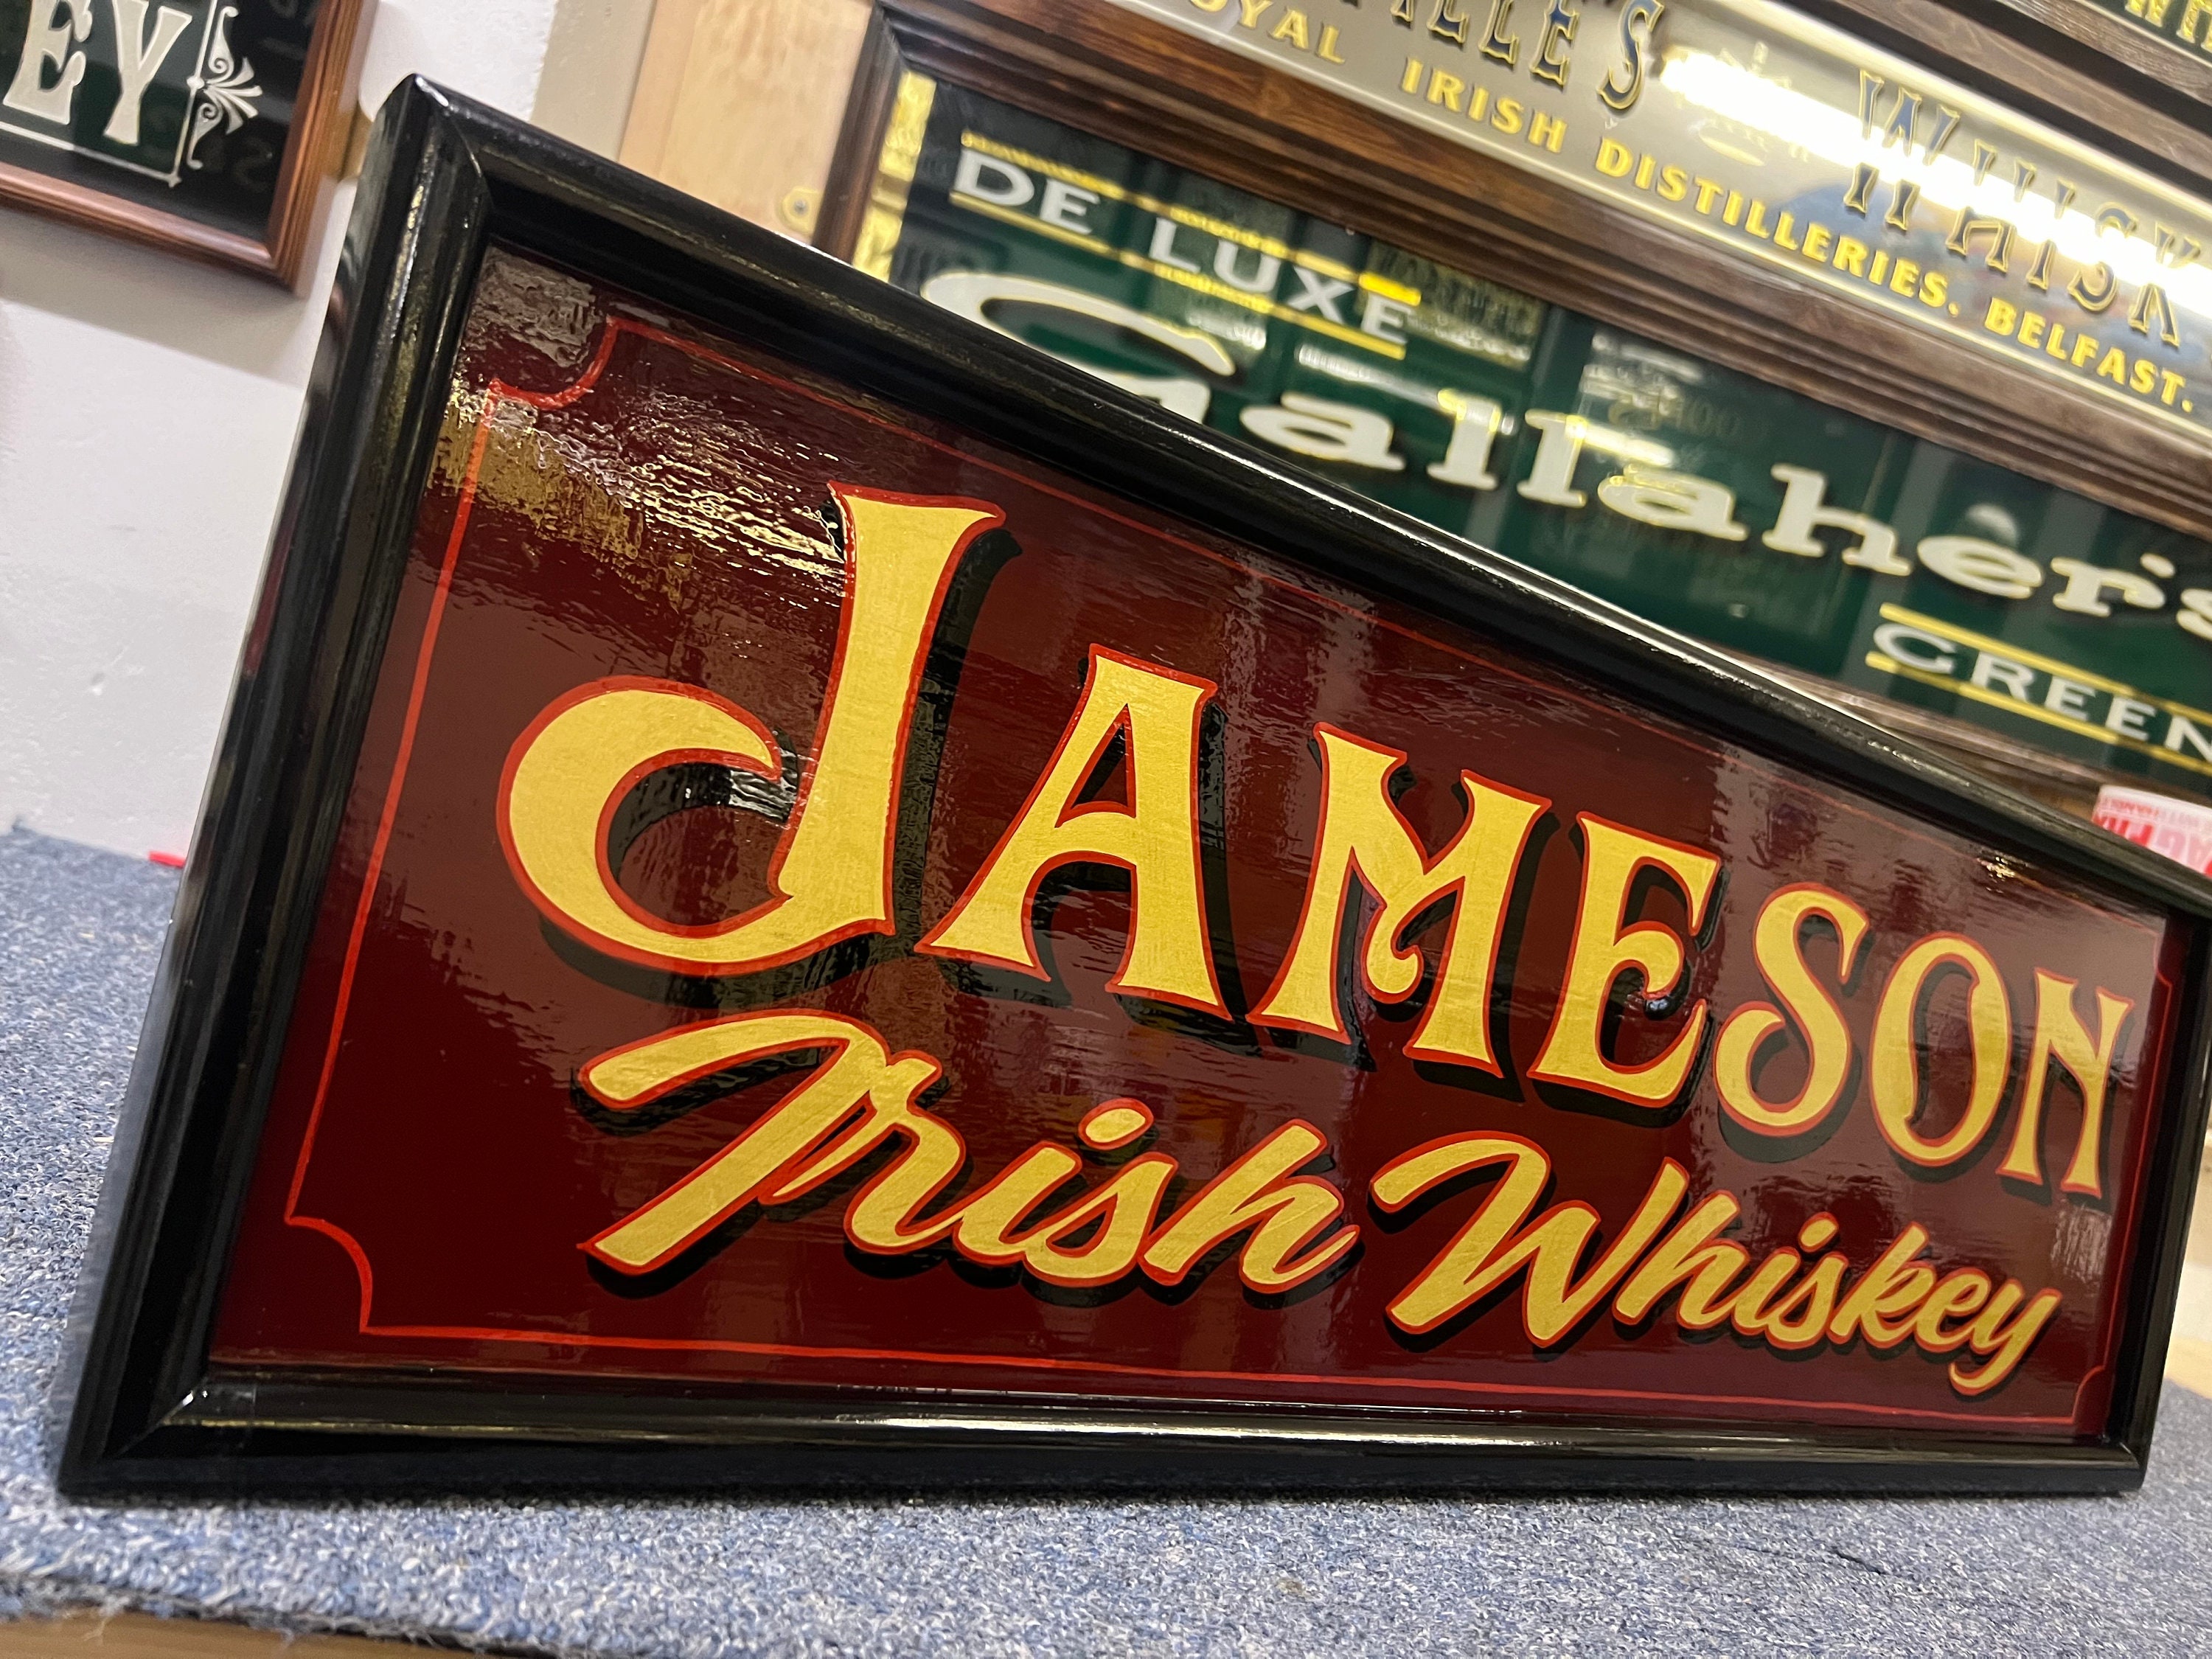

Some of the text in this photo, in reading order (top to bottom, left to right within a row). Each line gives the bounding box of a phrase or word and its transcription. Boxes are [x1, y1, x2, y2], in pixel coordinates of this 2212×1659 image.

[954, 150, 1410, 345] DE LUXE
[1402, 57, 1567, 153] IRISH
[1596, 136, 1959, 317] DISTILLERIES.
[1984, 296, 2194, 413] BELFAST.
[496, 481, 2135, 1197] JAMESON
[578, 1008, 2060, 1395] Irish Whiskey
